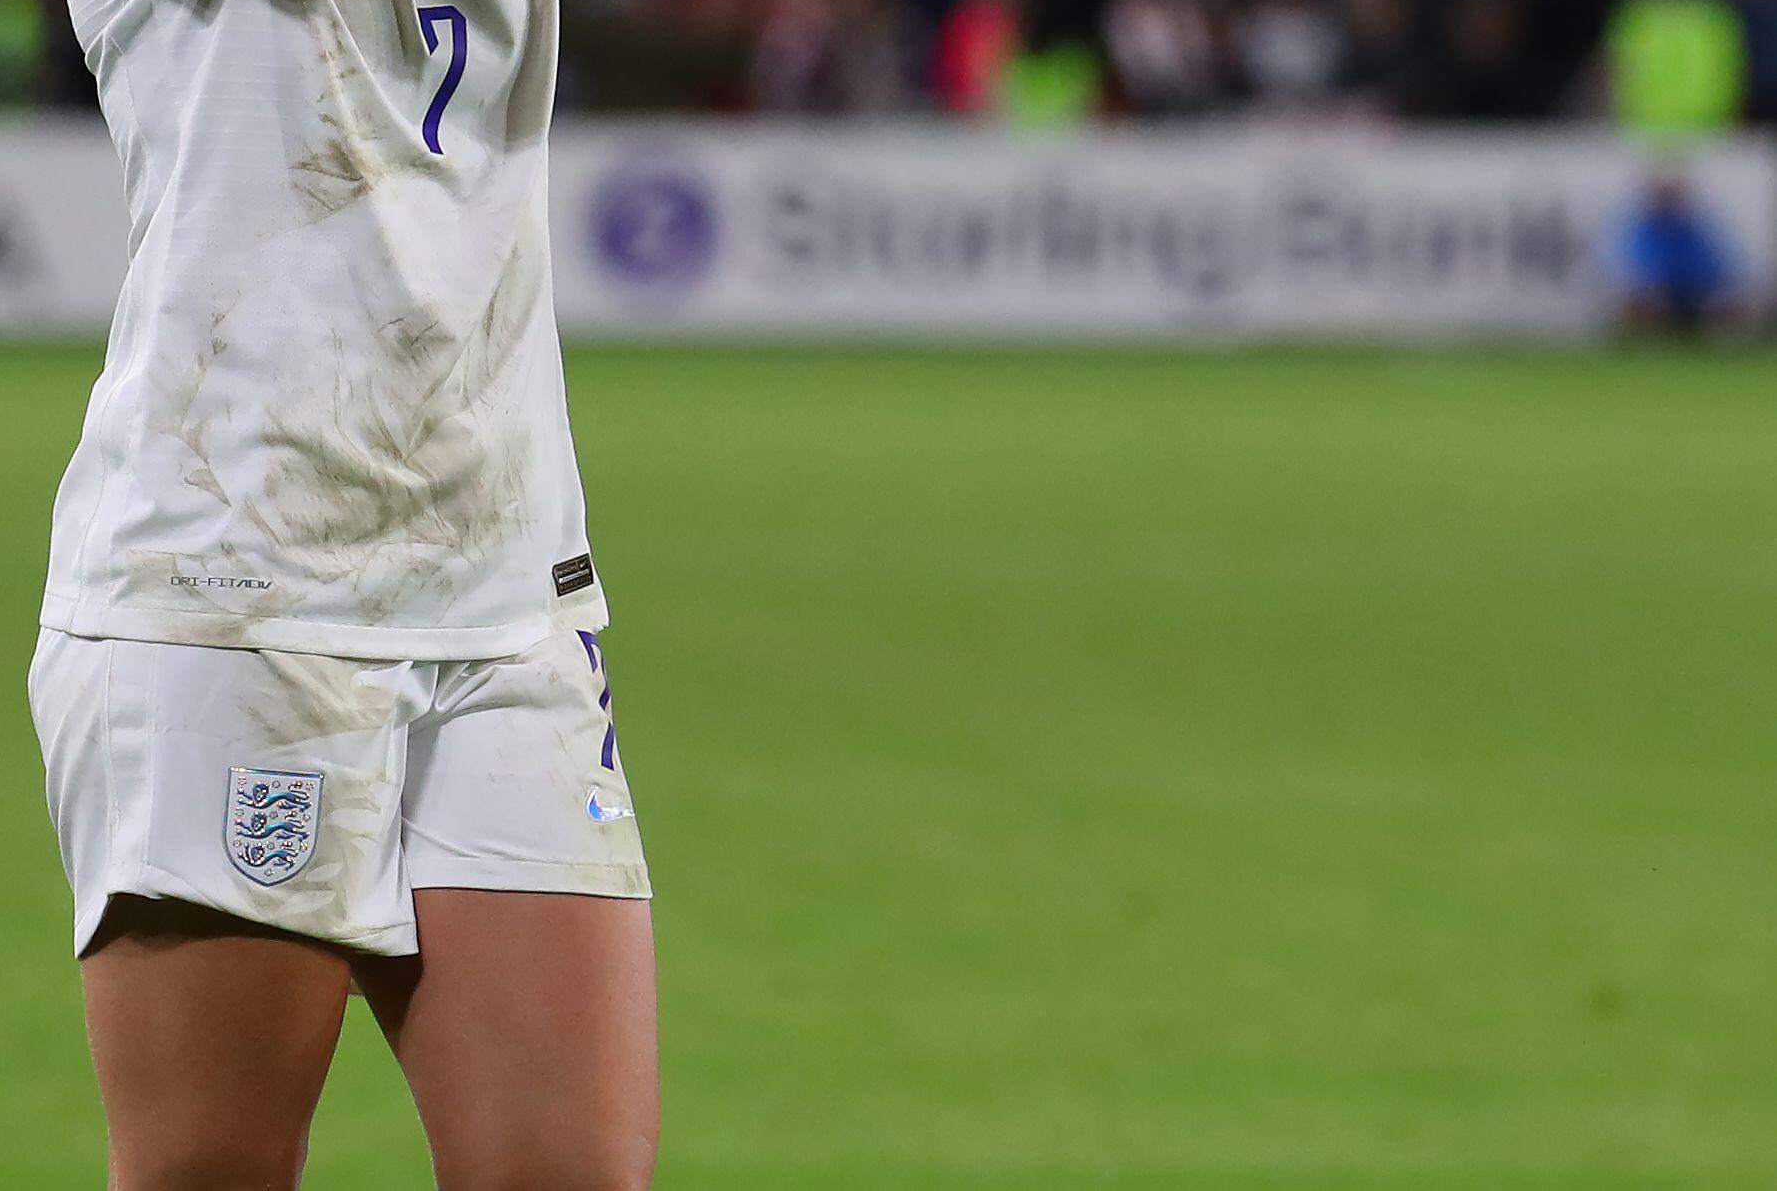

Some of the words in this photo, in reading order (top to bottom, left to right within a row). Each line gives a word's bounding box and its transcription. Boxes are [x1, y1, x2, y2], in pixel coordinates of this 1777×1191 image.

[417, 5, 467, 156] 7
[760, 173, 1226, 297] Starling
[1274, 173, 1584, 283] Bank
